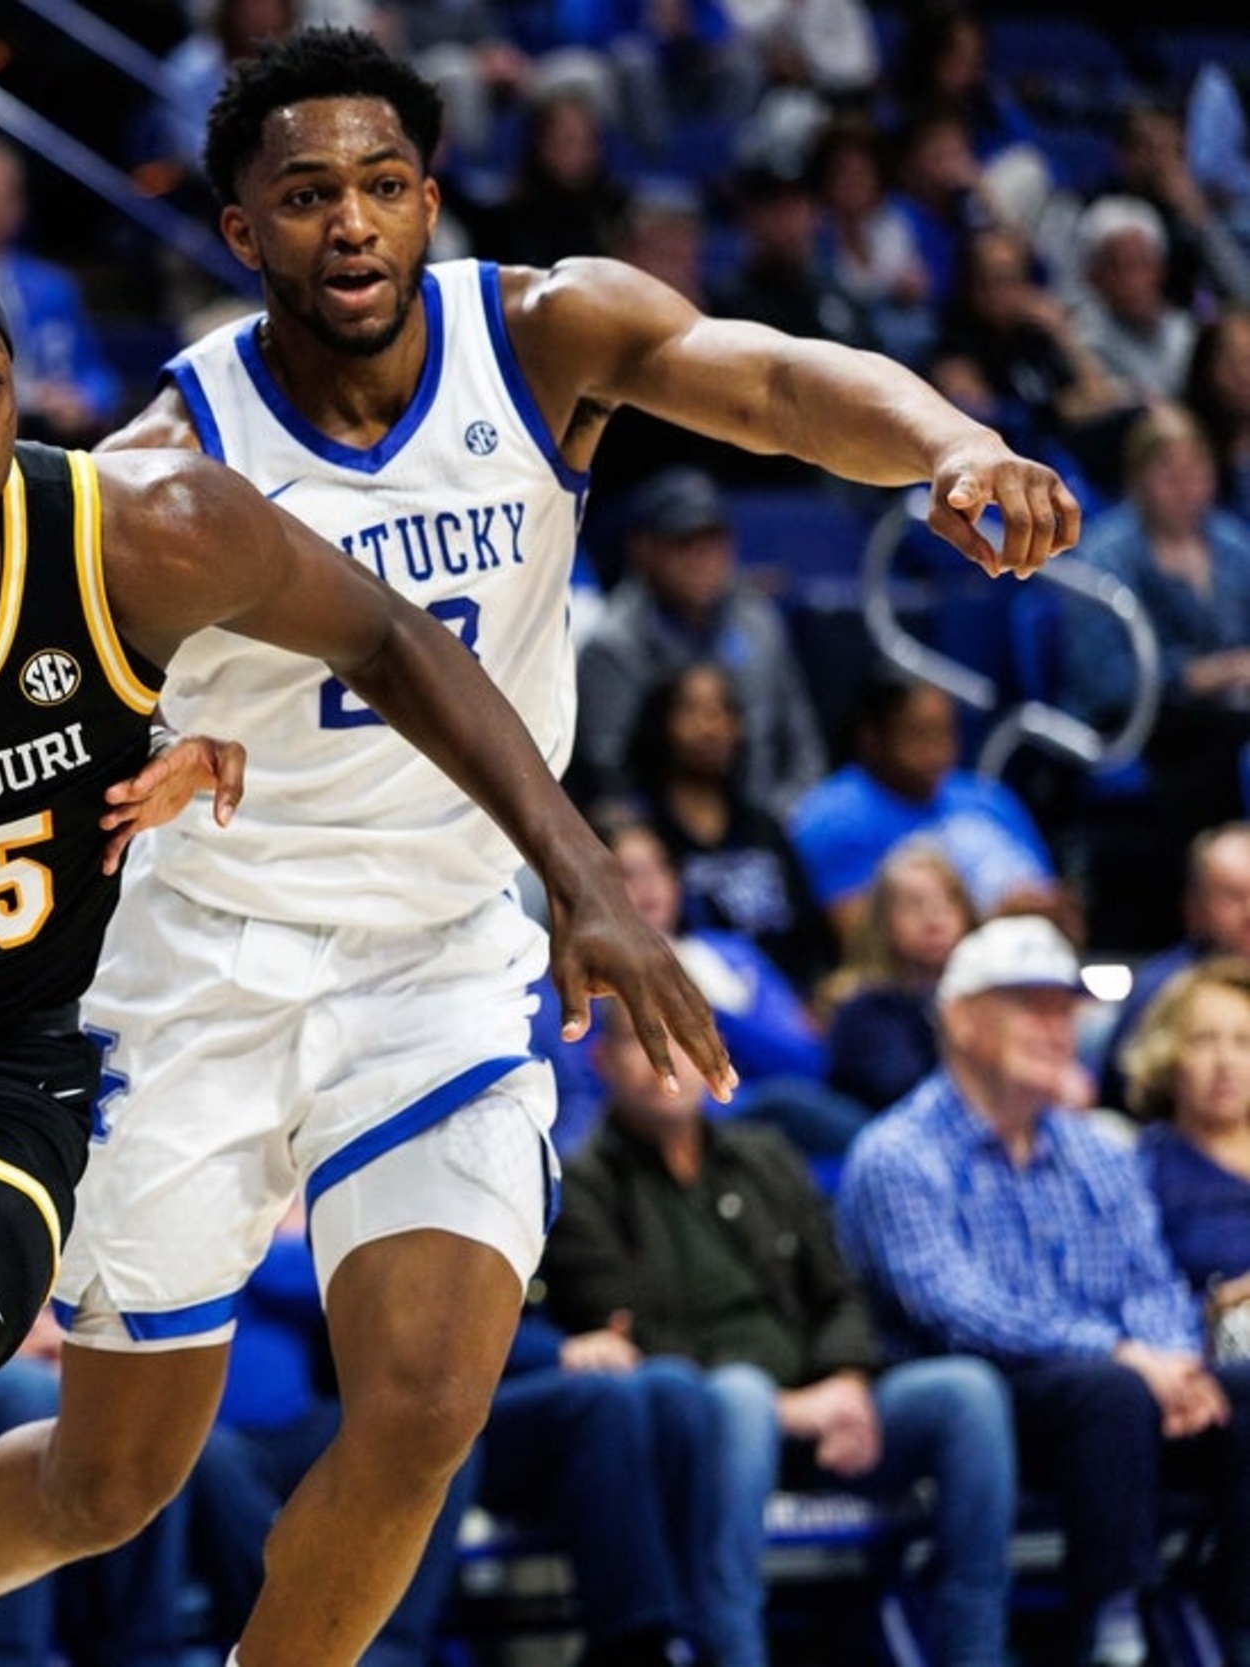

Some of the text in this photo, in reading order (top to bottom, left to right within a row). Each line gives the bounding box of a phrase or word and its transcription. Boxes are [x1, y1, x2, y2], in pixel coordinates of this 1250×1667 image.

[466, 422, 497, 454] SEC
[342, 502, 525, 582] TUCKY
[25, 654, 76, 701] SEC
